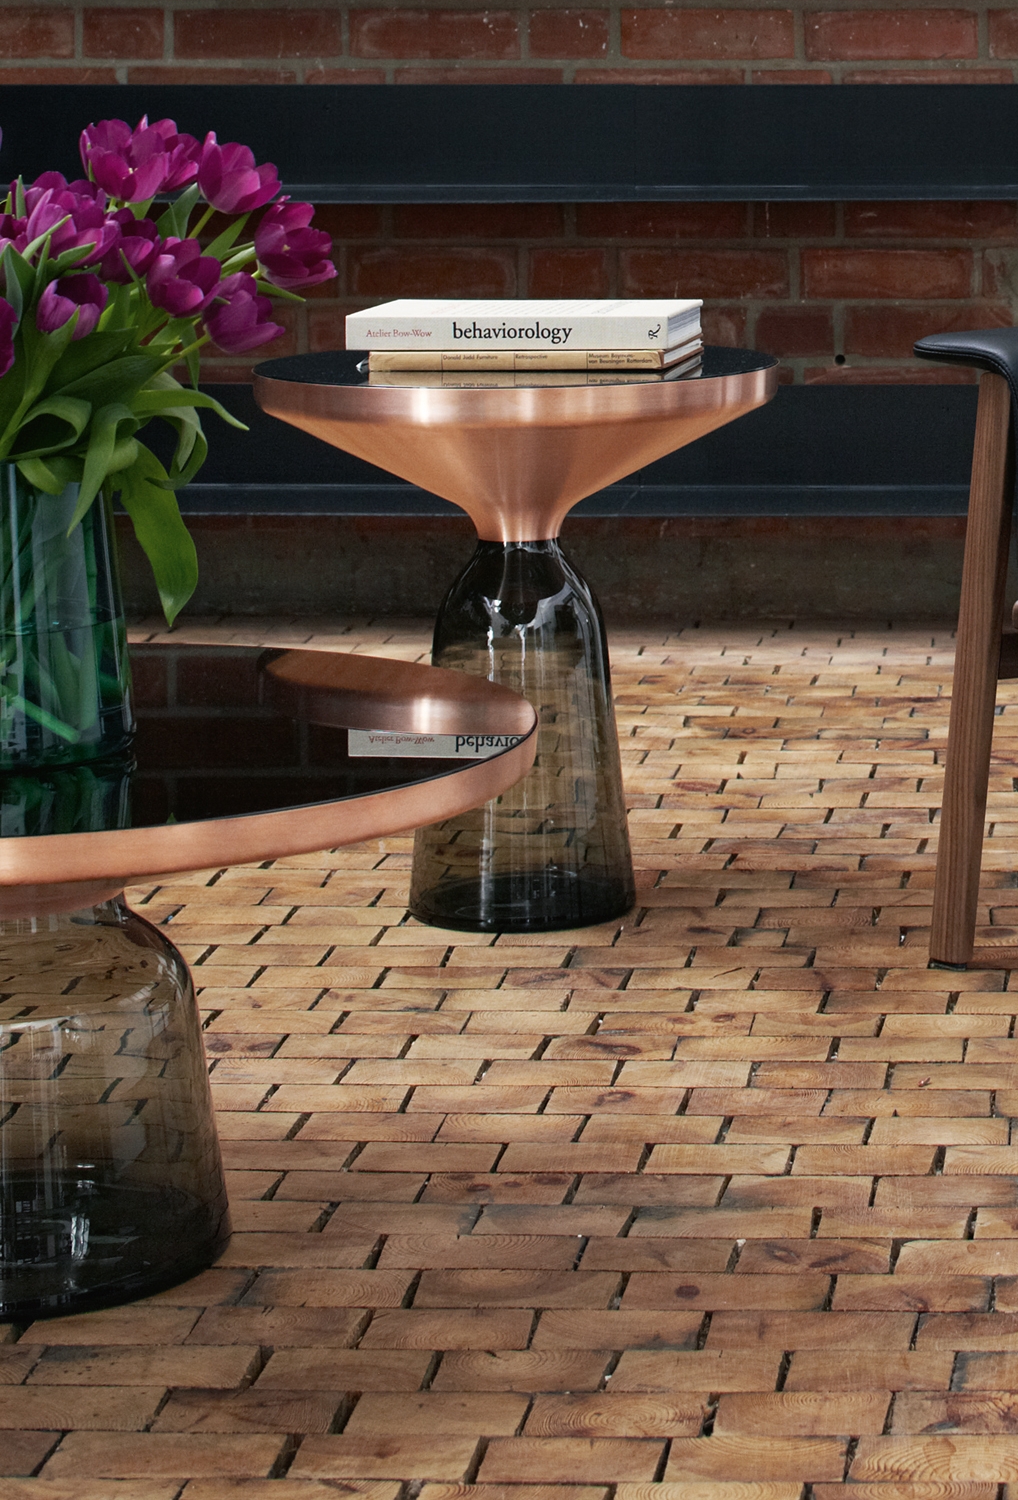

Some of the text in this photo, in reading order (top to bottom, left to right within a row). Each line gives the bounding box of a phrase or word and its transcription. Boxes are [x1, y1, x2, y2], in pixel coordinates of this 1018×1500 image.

[366, 329, 433, 338] Atelier Bow-Wow
[452, 322, 573, 345] behaviorology
[515, 353, 548, 361] Retrospective
